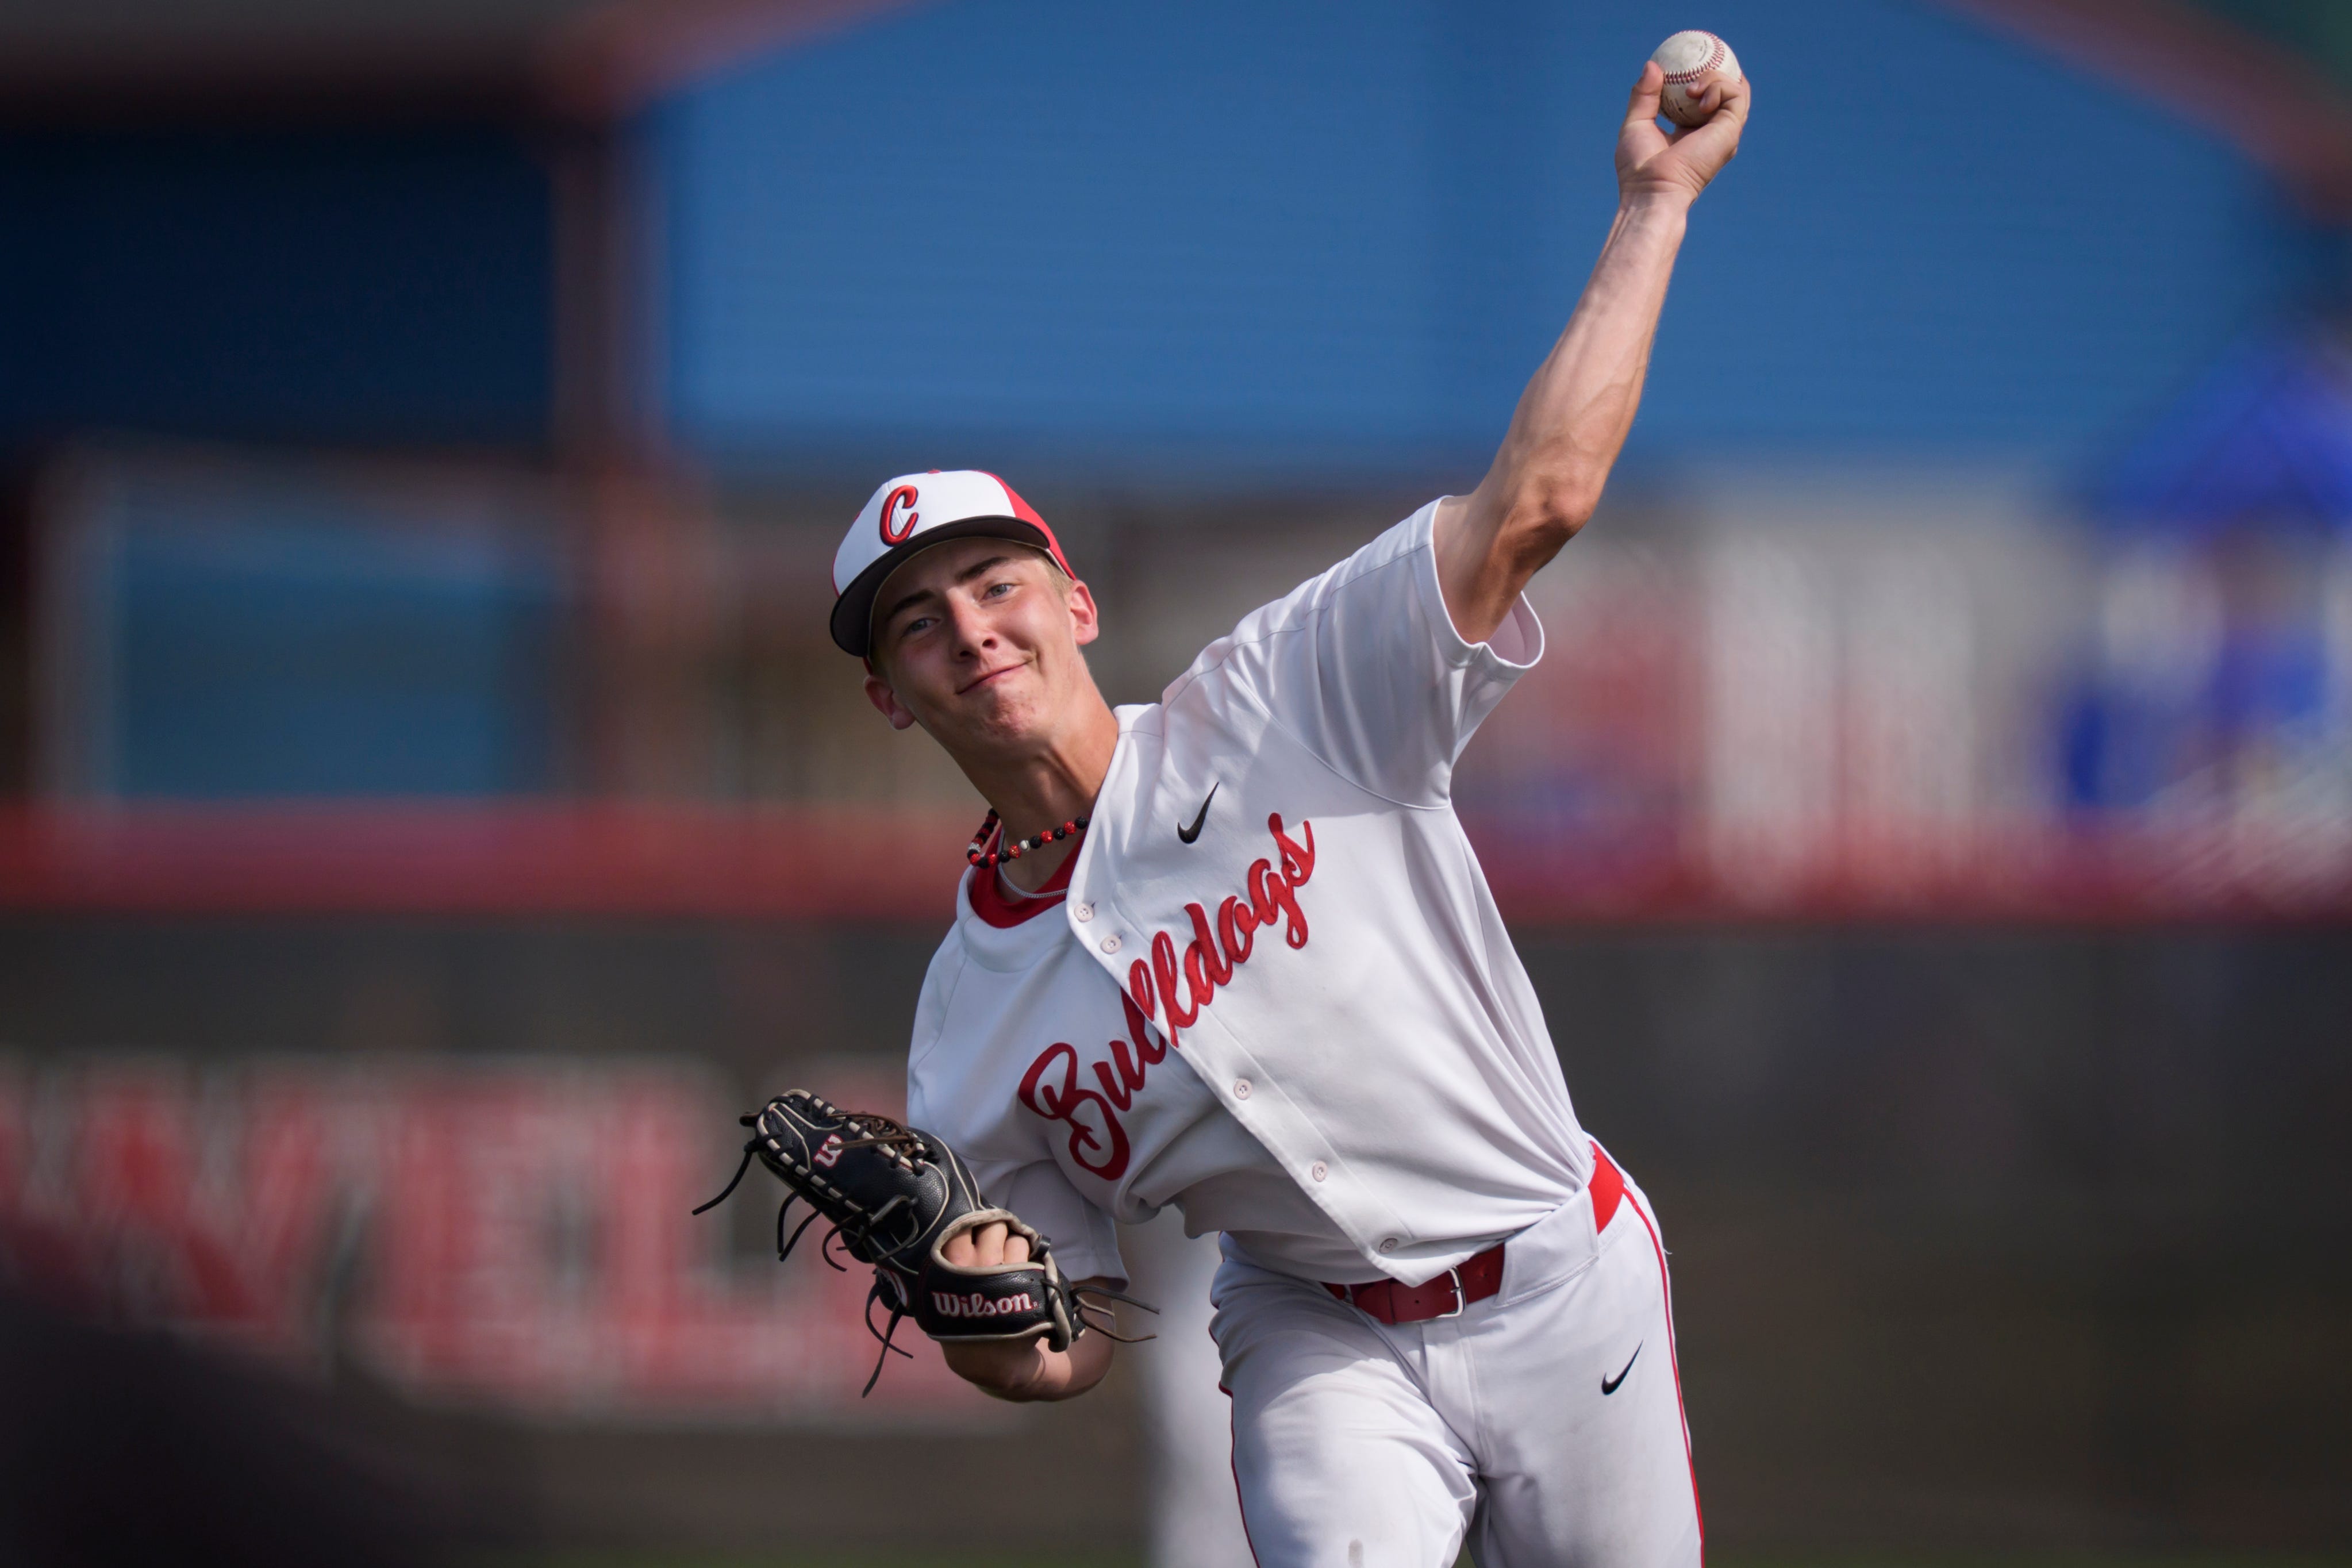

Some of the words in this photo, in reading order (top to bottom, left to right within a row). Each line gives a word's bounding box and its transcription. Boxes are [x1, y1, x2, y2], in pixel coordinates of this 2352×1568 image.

[880, 485, 919, 547] C
[1018, 812, 1315, 1182] Bulldogs
[931, 1292, 1032, 1317] Wilson
